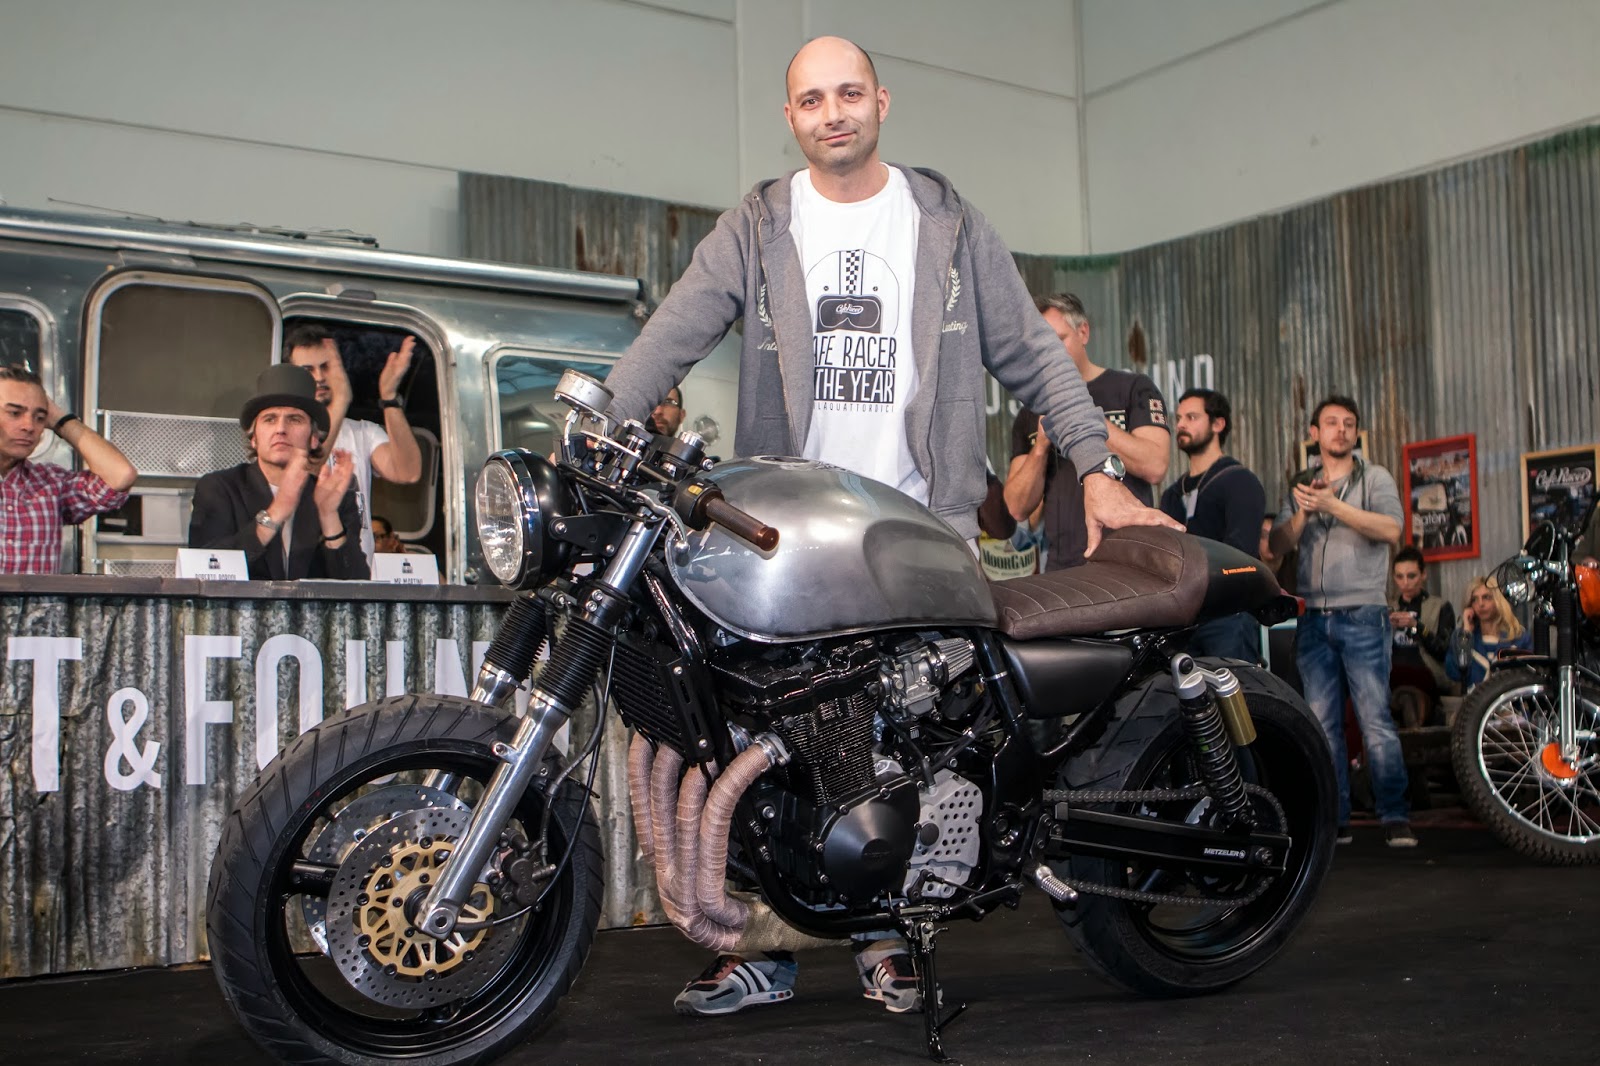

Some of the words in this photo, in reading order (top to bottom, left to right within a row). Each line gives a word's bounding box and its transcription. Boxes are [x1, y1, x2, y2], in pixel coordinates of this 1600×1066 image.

[813, 335, 836, 366] AFE
[843, 336, 897, 368] RACER
[816, 368, 847, 400] THE
[850, 370, 894, 403] YEAR
[103, 686, 162, 791] &
[1204, 848, 1240, 857] METZELER
